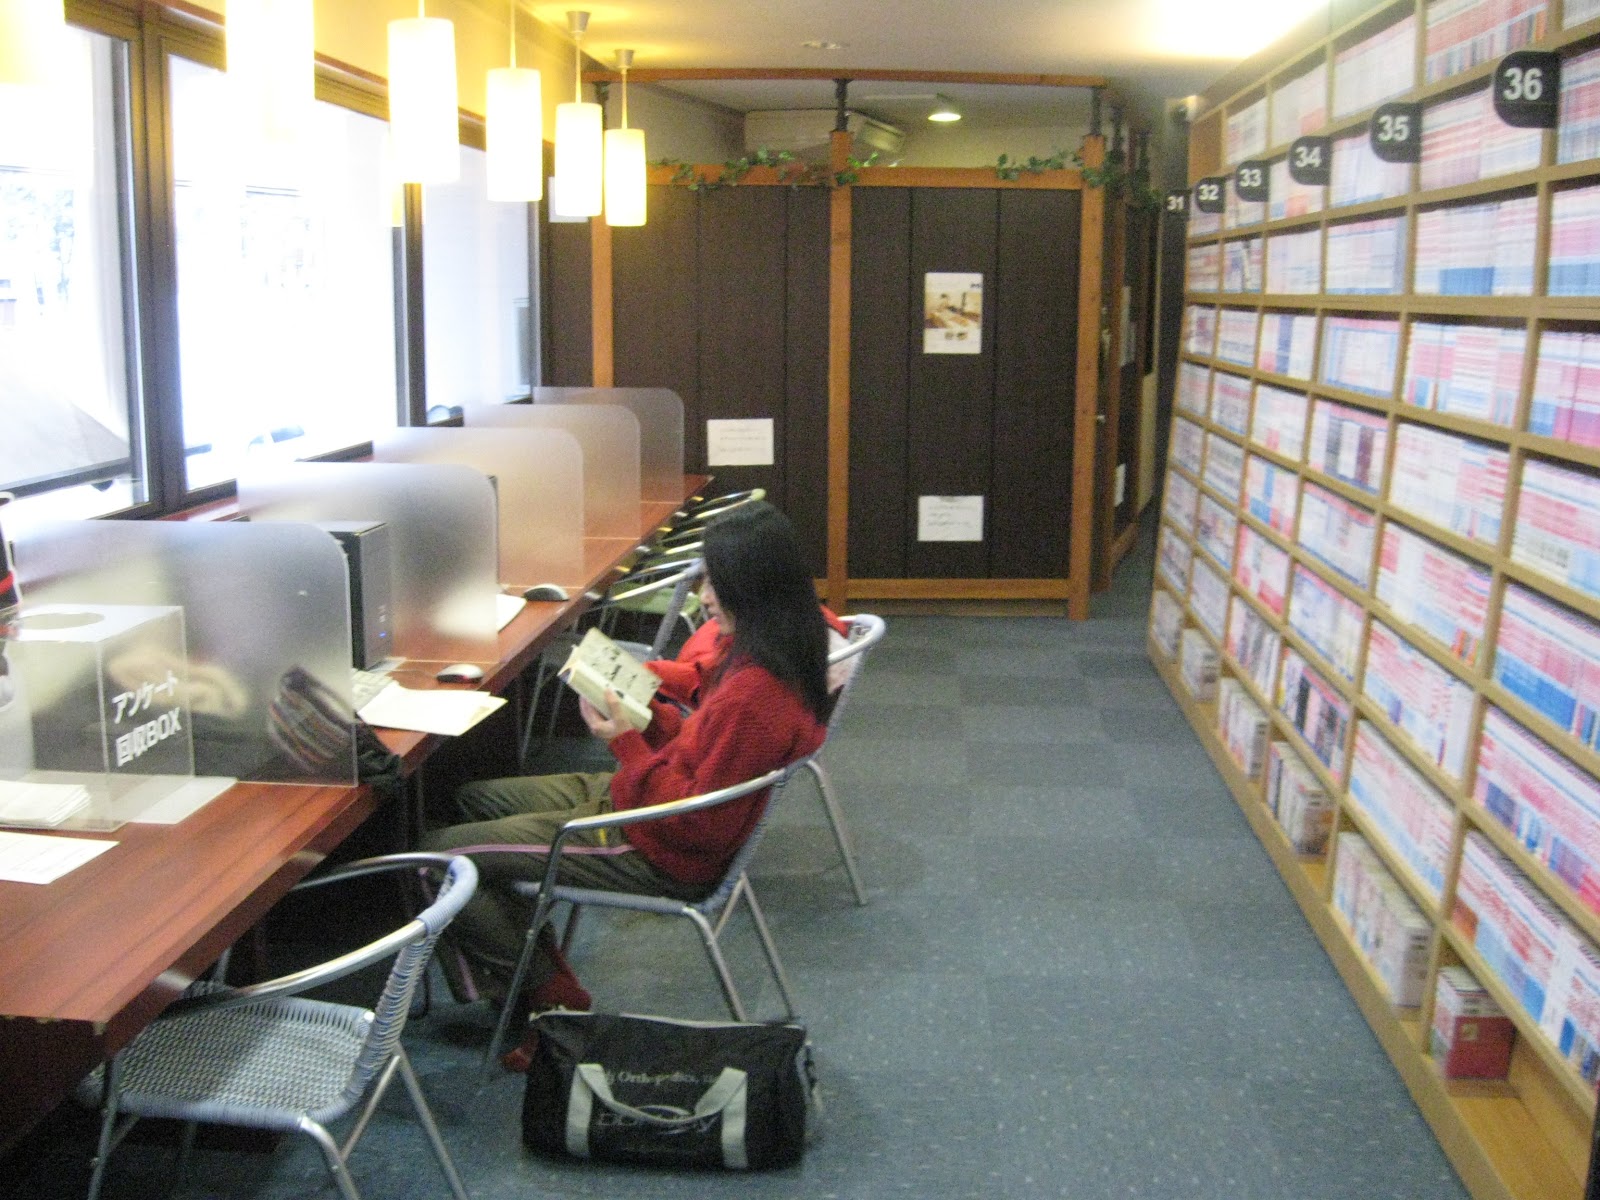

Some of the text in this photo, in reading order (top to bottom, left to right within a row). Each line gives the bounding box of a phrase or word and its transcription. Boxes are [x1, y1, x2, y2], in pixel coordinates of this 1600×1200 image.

[1503, 67, 1543, 101] 36
[1377, 115, 1411, 142] 35
[1295, 146, 1323, 168] 34
[1238, 168, 1262, 188] 33
[1166, 195, 1185, 211] 31
[1198, 184, 1219, 201] 32
[111, 669, 178, 724] アンケート
[116, 706, 181, 767] 回収BOX
